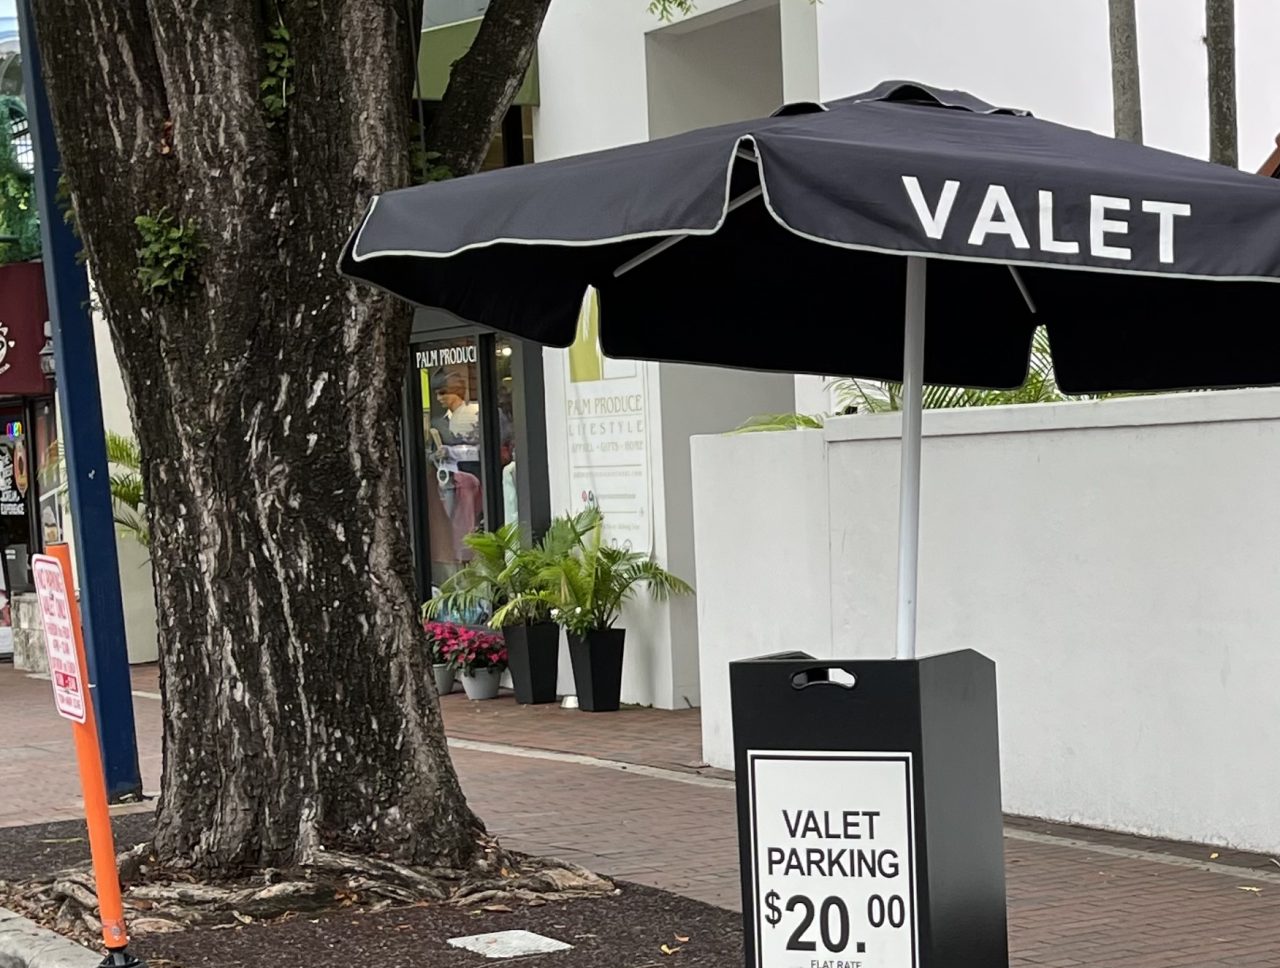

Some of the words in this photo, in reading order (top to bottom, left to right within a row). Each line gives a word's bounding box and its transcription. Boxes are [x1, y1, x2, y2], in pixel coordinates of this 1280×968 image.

[901, 175, 1192, 264] VALET
[416, 349, 438, 368] PALM
[594, 394, 643, 414] PRODUCE
[782, 810, 880, 839] VALET
[767, 847, 899, 878] PARKING
